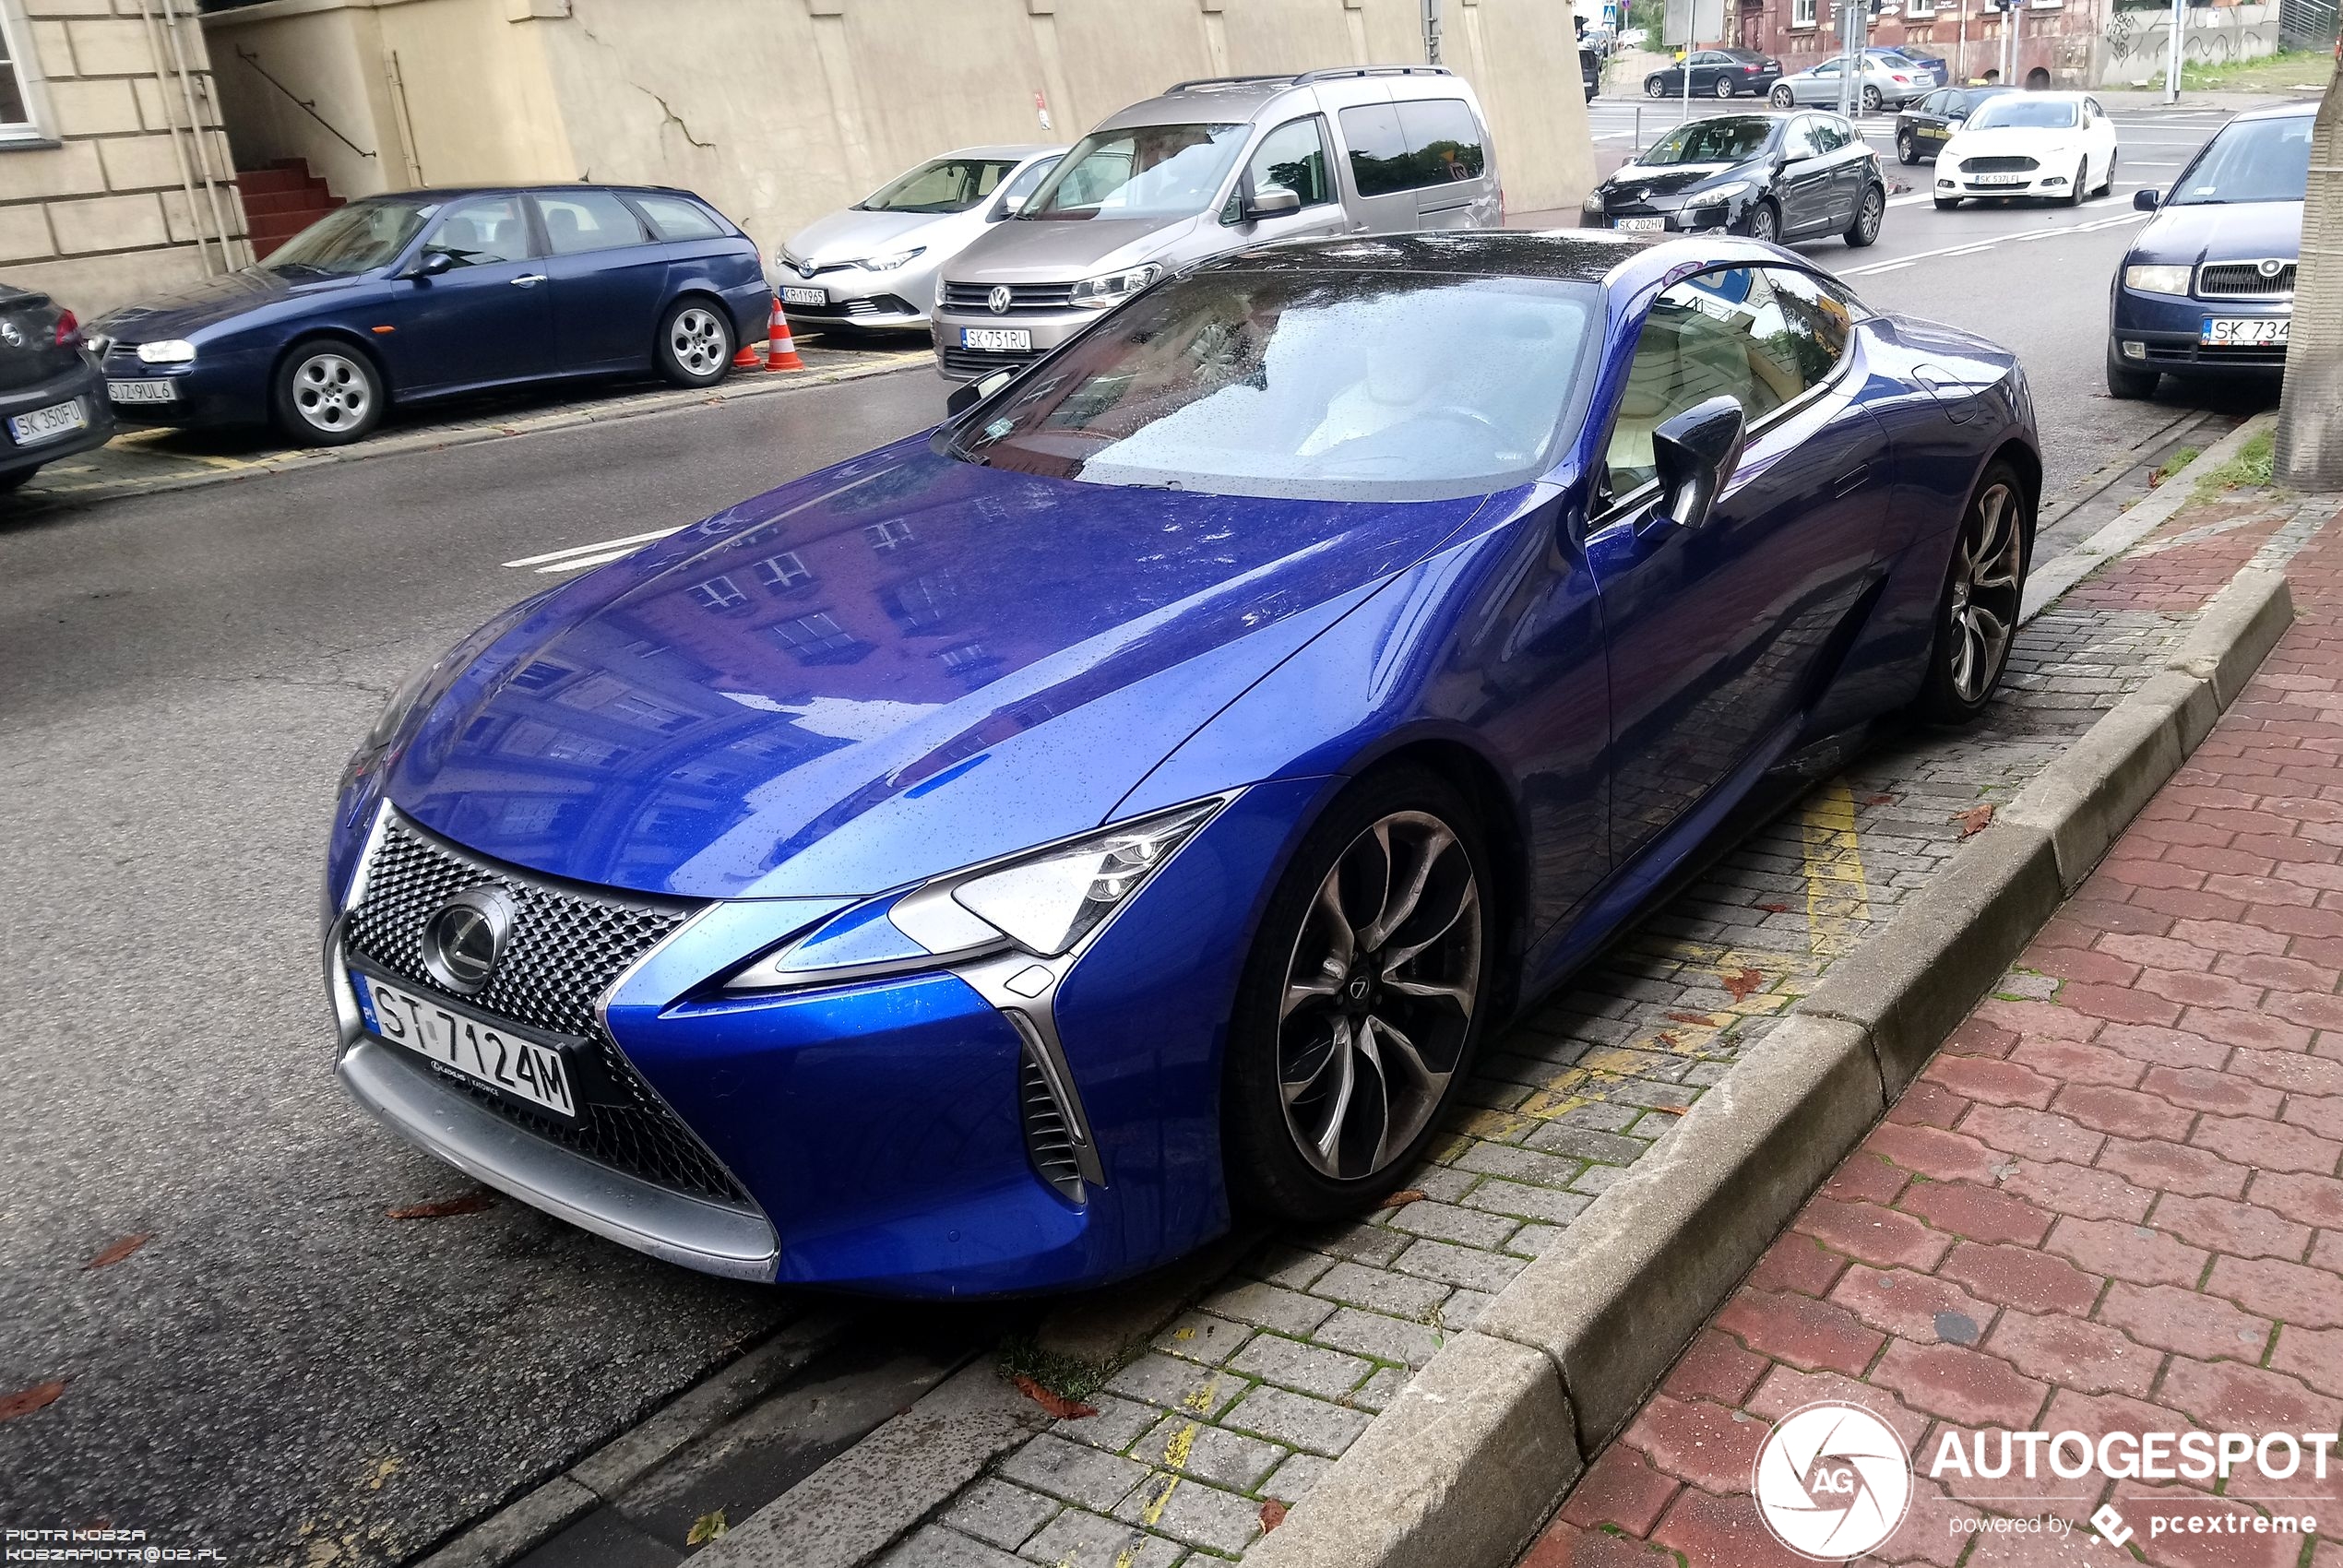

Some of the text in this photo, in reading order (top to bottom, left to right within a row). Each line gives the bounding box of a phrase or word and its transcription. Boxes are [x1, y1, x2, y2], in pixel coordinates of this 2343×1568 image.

[1619, 219, 1663, 231] SK 202HV
[969, 330, 1027, 348] SK 751RU
[2215, 321, 2244, 339] SK
[17, 403, 80, 436] SK 350FU
[375, 985, 570, 1110] ST 7124M
